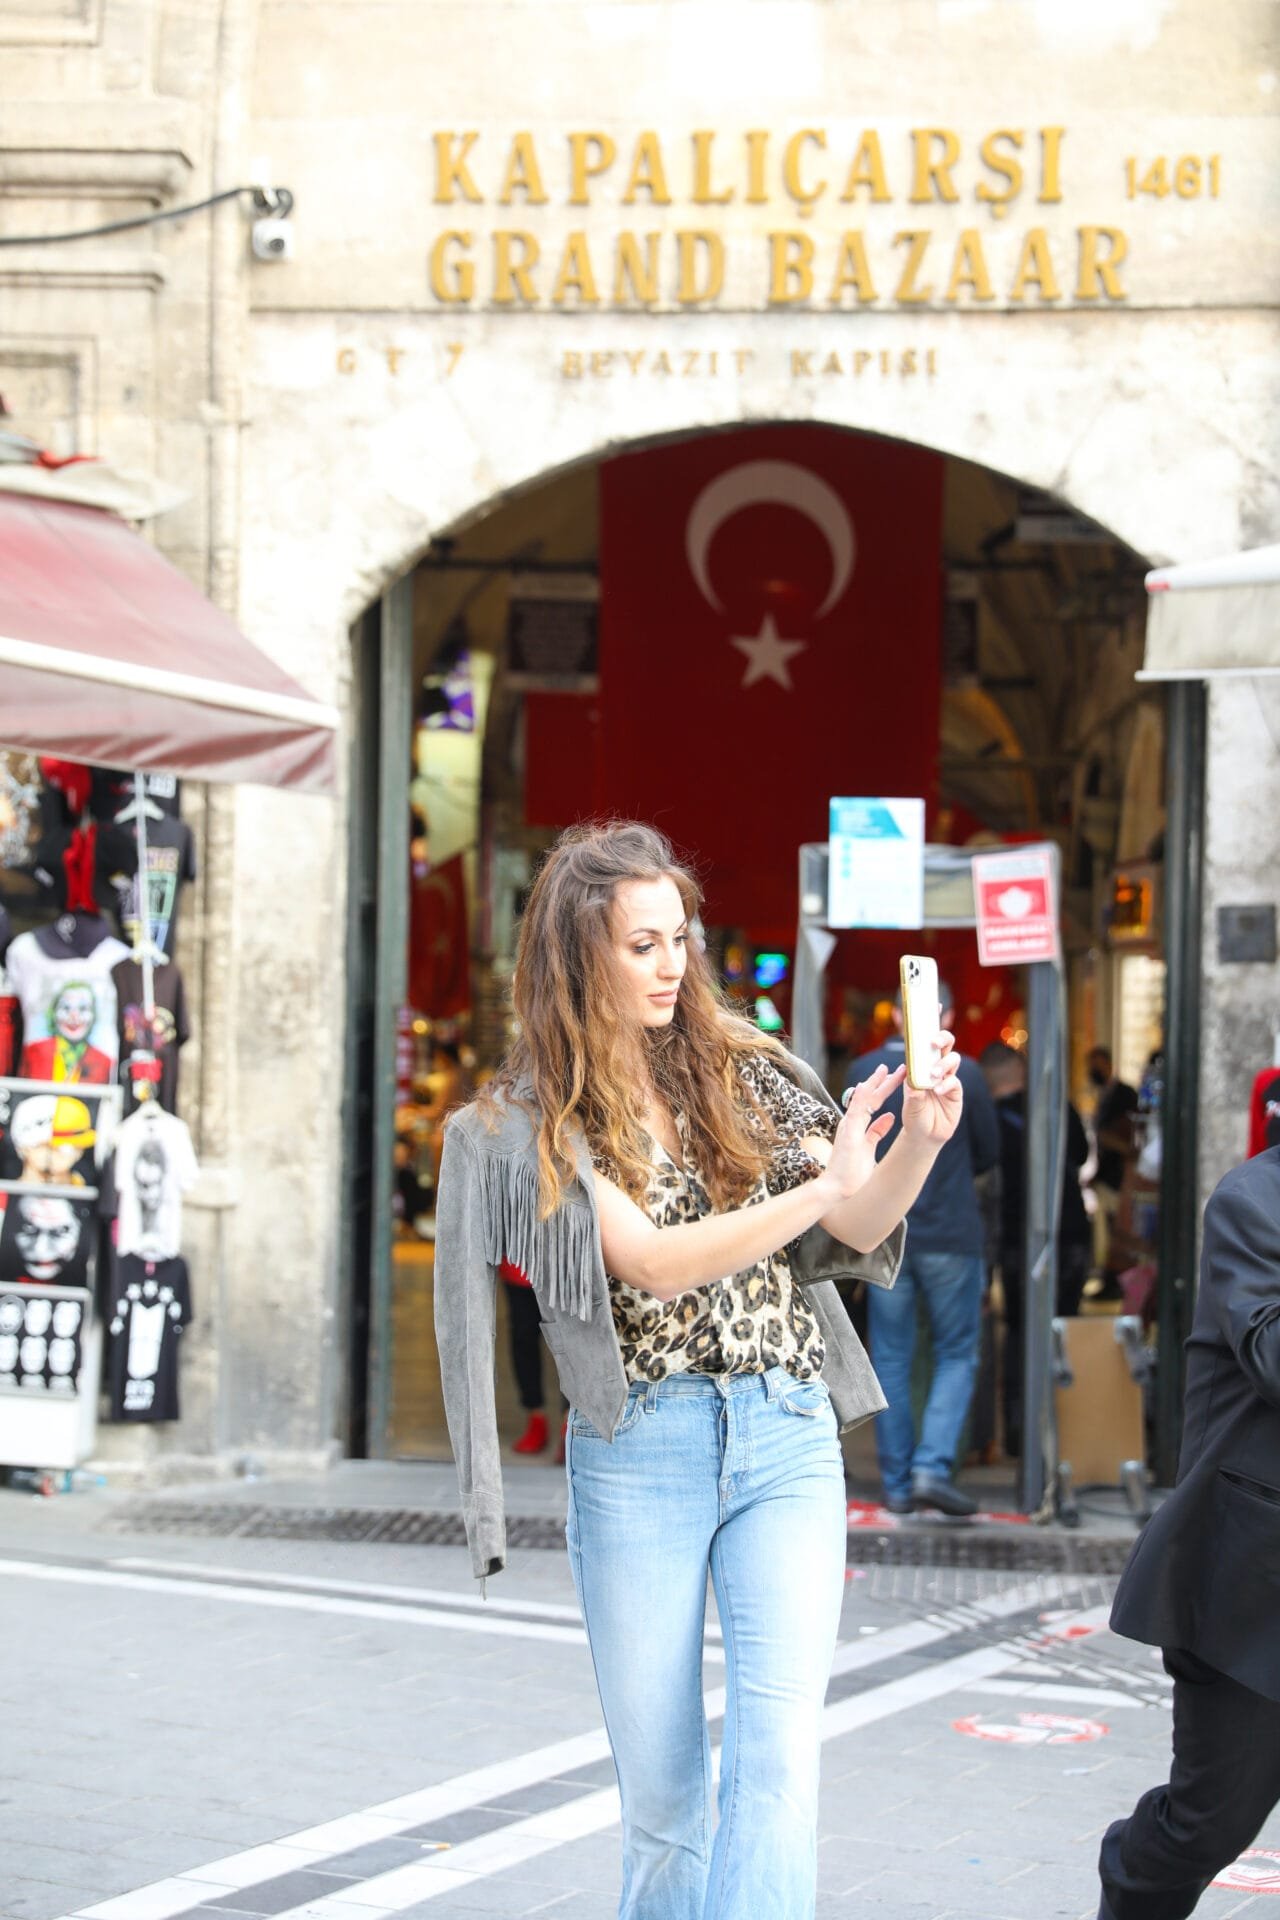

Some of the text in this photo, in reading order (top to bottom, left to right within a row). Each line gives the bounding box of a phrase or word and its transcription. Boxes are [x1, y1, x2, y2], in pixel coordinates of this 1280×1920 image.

[433, 128, 1065, 218] KAPALIÇARŞI
[1124, 154, 1221, 199] 1461
[429, 226, 1129, 304] GRAND BAZAAR
[561, 347, 938, 380] BEYAZIT KAPISI
